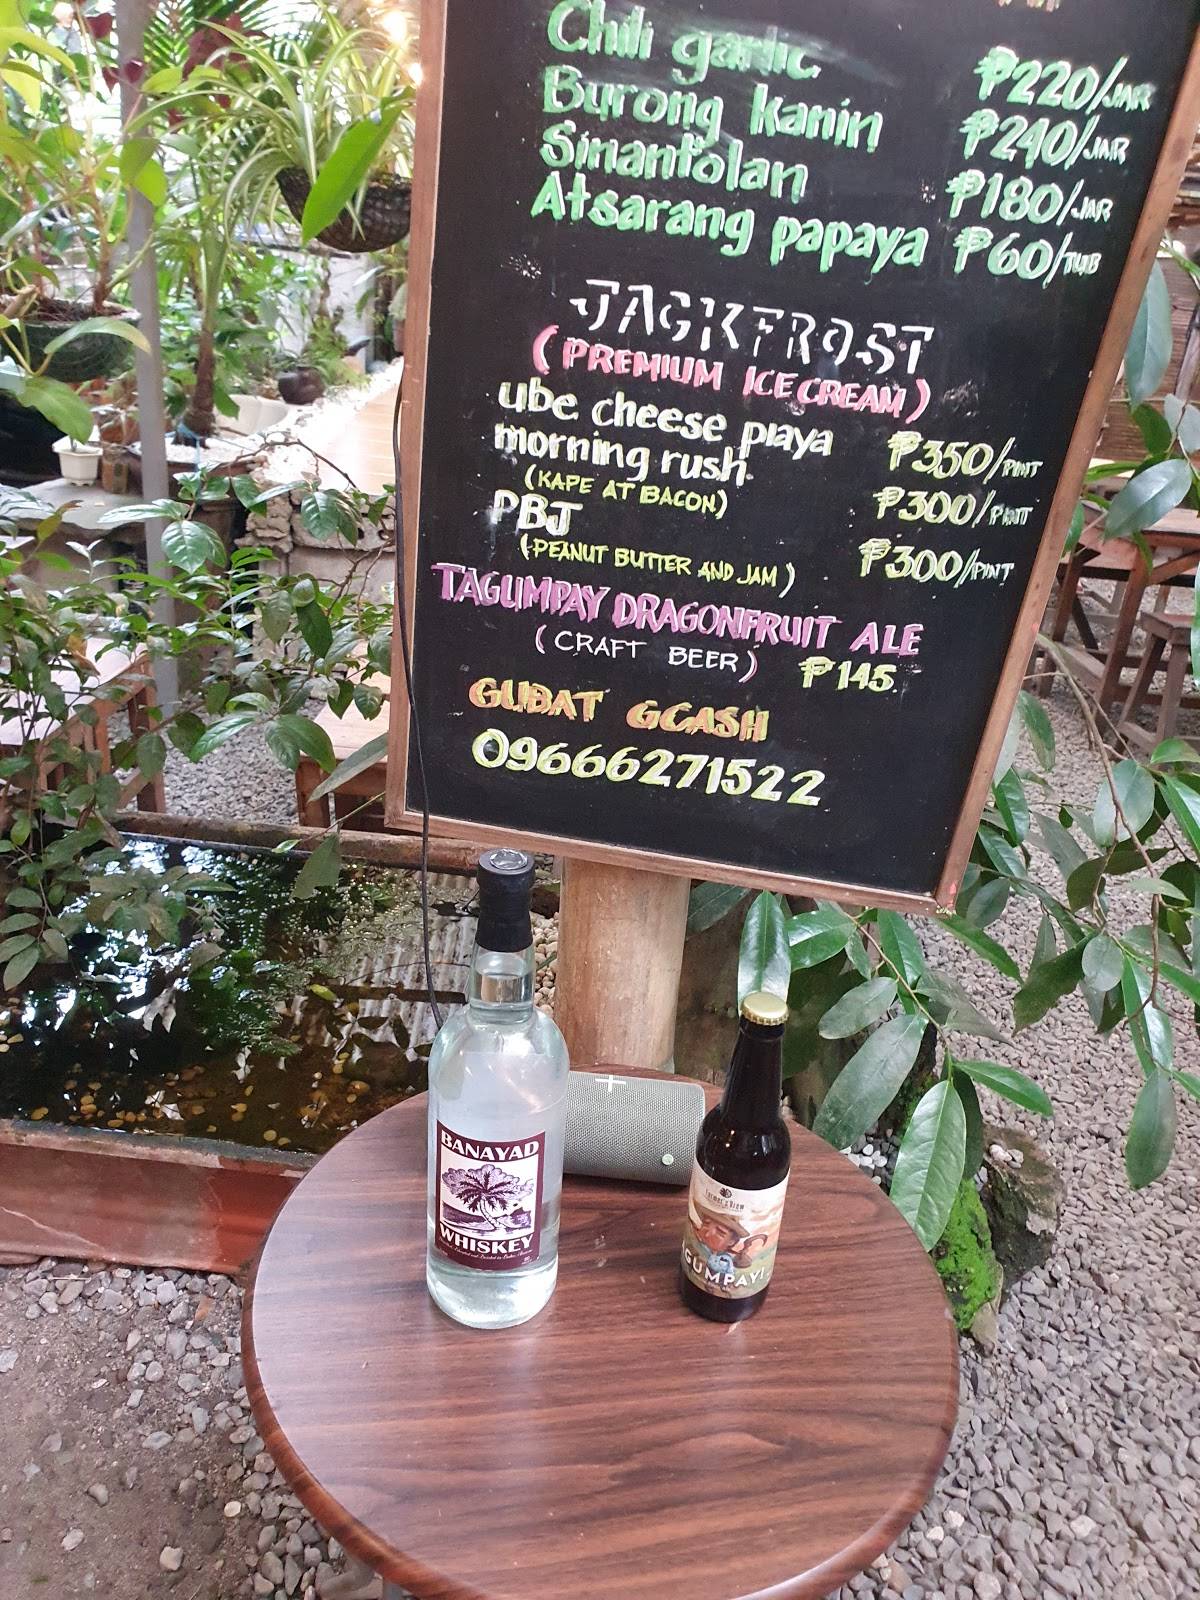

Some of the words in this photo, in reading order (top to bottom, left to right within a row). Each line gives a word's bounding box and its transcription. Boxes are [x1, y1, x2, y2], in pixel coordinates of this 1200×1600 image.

[547, 0, 654, 60] Chili
[671, 26, 822, 85] garlic
[542, 65, 724, 149] Burong
[540, 119, 809, 204] Sinantolan
[531, 171, 756, 257] Atsarang
[769, 214, 930, 275] papaya
[569, 278, 935, 375] JACKFROST
[498, 376, 579, 422] ube
[590, 391, 728, 442] cheese
[740, 420, 833, 461] playa
[742, 365, 799, 400] ICE
[493, 423, 650, 483] morning
[490, 488, 584, 537] PBJ
[524, 463, 595, 493] (KAPE
[602, 479, 637, 500] AT
[640, 483, 728, 521] BACON)
[613, 547, 692, 576] BUTTER
[697, 560, 735, 583] AND
[430, 562, 611, 624] TAGUMPAY
[611, 590, 843, 650] DRAGONFRUIT
[848, 622, 925, 657] ALE
[468, 677, 605, 722] GUBAT
[625, 700, 770, 743] GCASH
[470, 728, 827, 807] 09666271522
[440, 1129, 541, 1162] BANAYAD
[439, 1225, 534, 1255] WHISKEY
